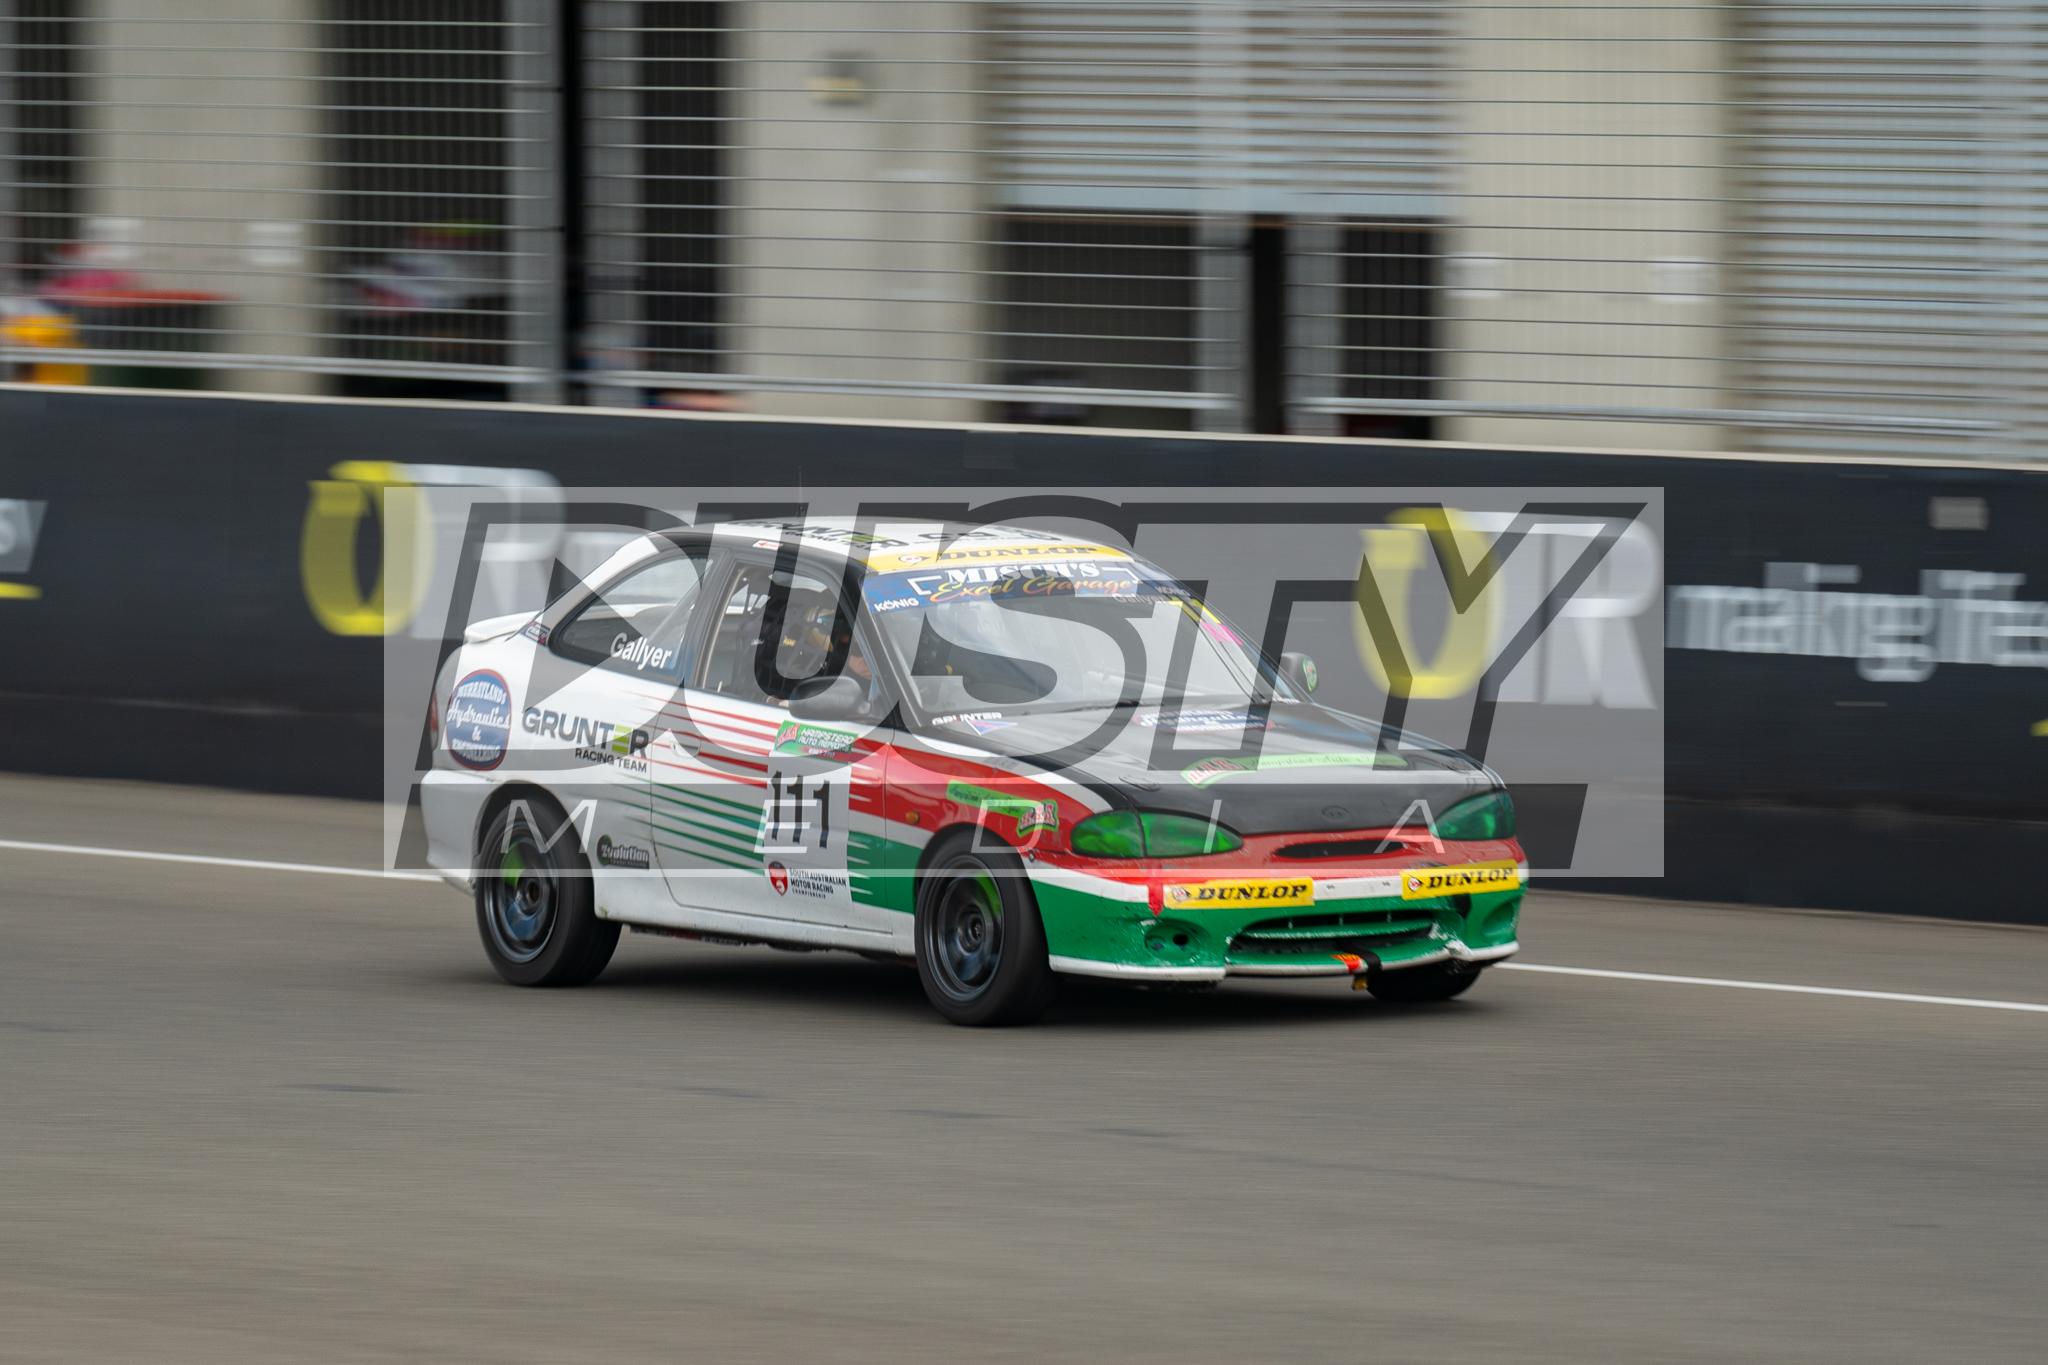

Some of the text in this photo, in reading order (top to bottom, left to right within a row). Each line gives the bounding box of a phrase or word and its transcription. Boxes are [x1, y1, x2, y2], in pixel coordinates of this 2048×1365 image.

[939, 545, 1098, 563] DUNLOP
[945, 560, 1100, 585] MISCH'S
[930, 576, 1132, 602] Excel Garage
[874, 598, 920, 613] KÖNIG
[610, 632, 673, 671] Gallyer
[447, 700, 510, 730] Hydraulics
[471, 726, 481, 741] &
[521, 706, 649, 760] GRUNTER
[574, 748, 647, 774] RACING TEAM
[771, 771, 830, 849] 111
[790, 867, 847, 888] SOUTH AUSTRALIAN
[791, 878, 834, 895] MOTOR RACING
[1428, 867, 1515, 889] DUNLOP
[1198, 884, 1308, 901] DUNLOP
